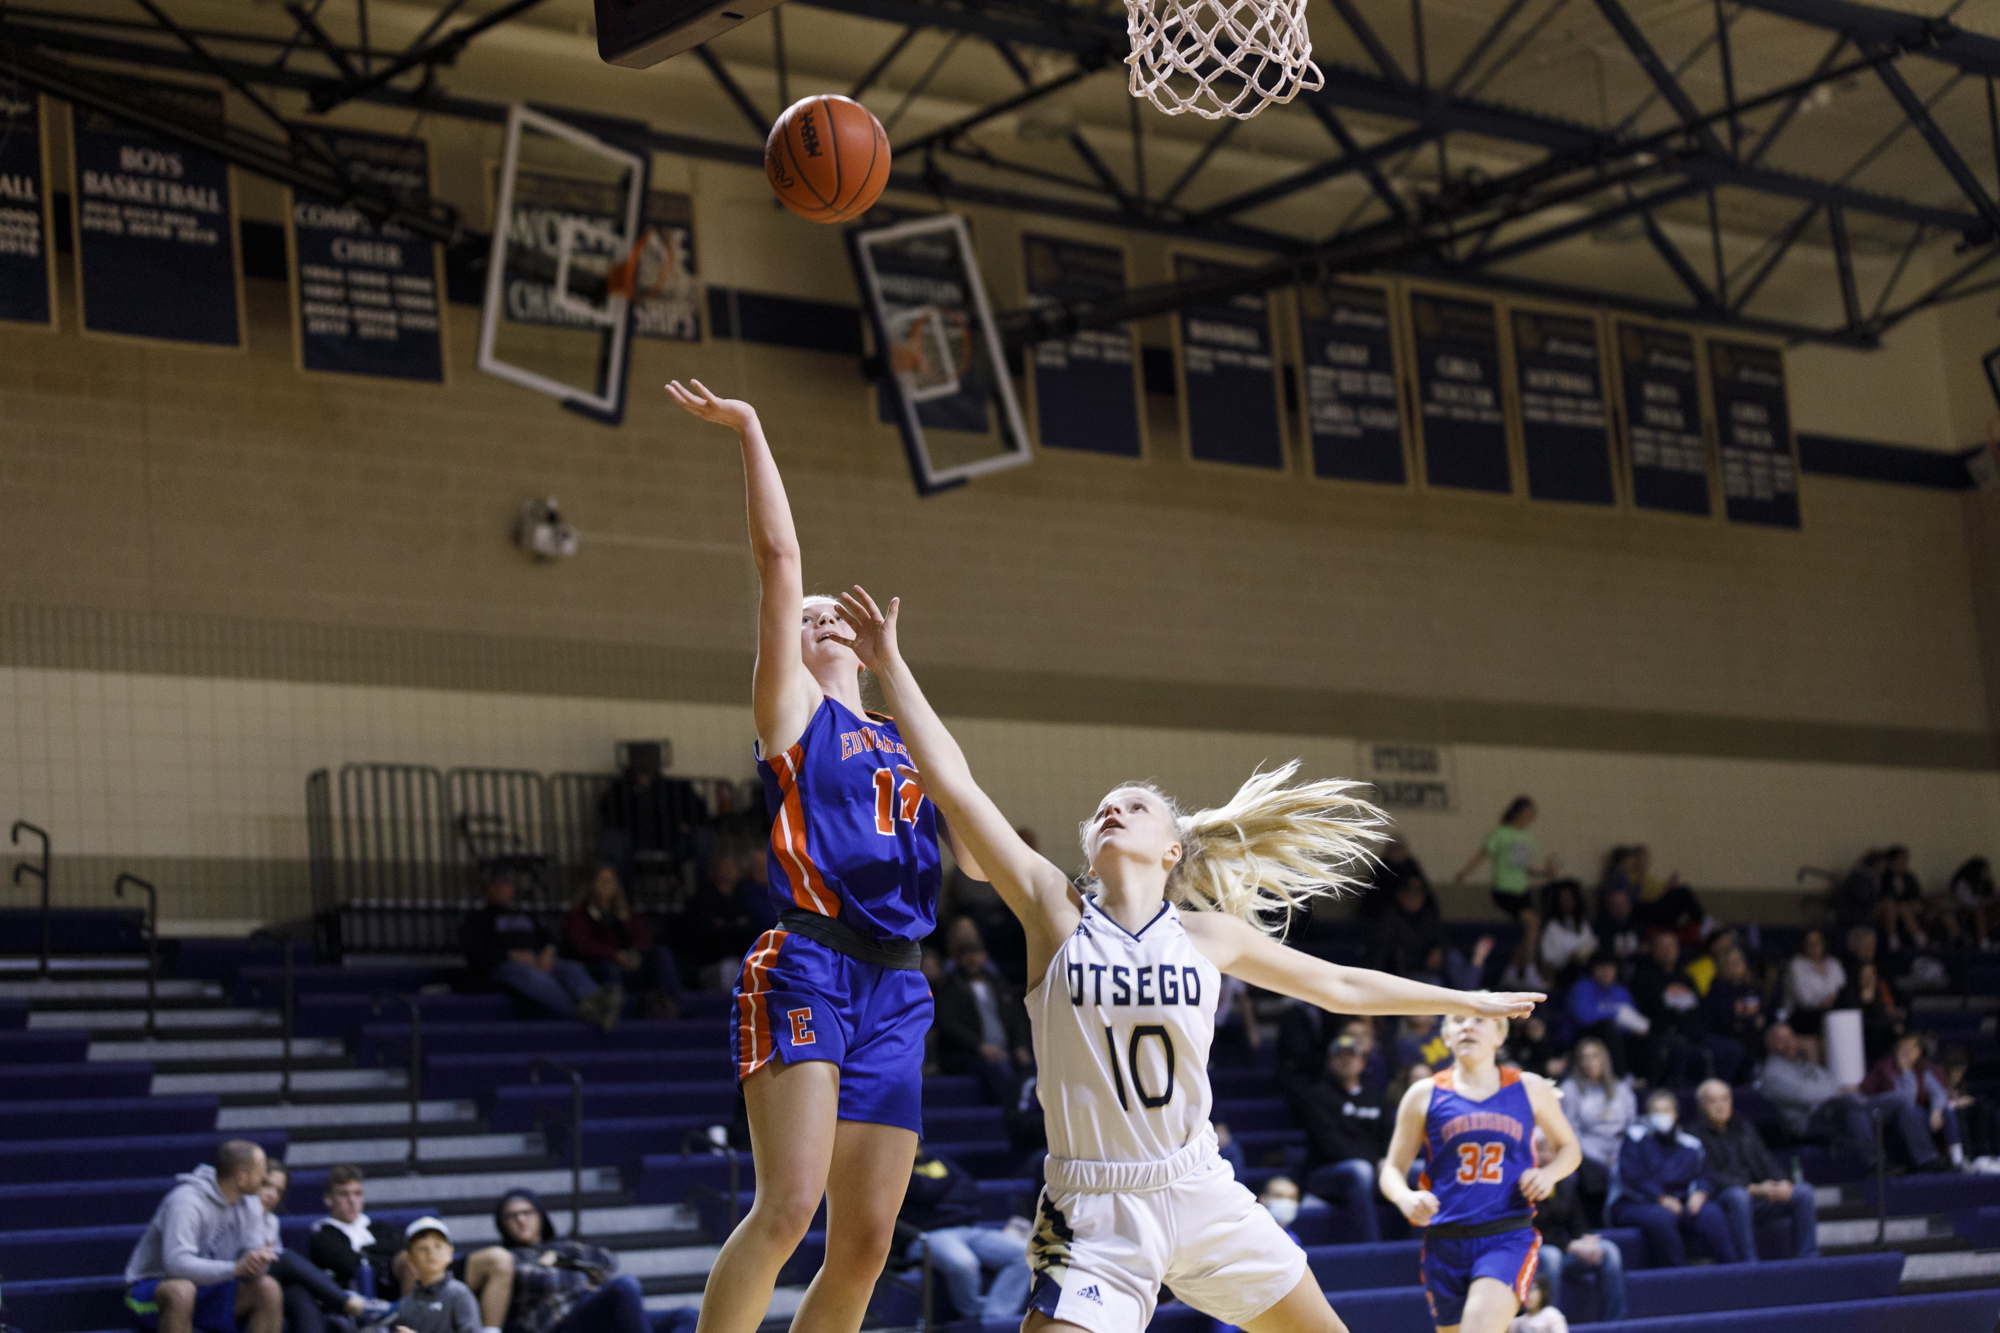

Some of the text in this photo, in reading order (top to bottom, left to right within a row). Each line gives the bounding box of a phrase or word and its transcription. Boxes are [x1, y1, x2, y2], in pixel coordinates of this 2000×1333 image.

[120, 145, 184, 178] BOYS
[83, 169, 222, 213] BASKETBALL
[1069, 963, 1201, 1007] OTSEGO
[787, 1007, 816, 1046] E
[1105, 1024, 1176, 1112] 10
[1456, 1142, 1506, 1185] 32
